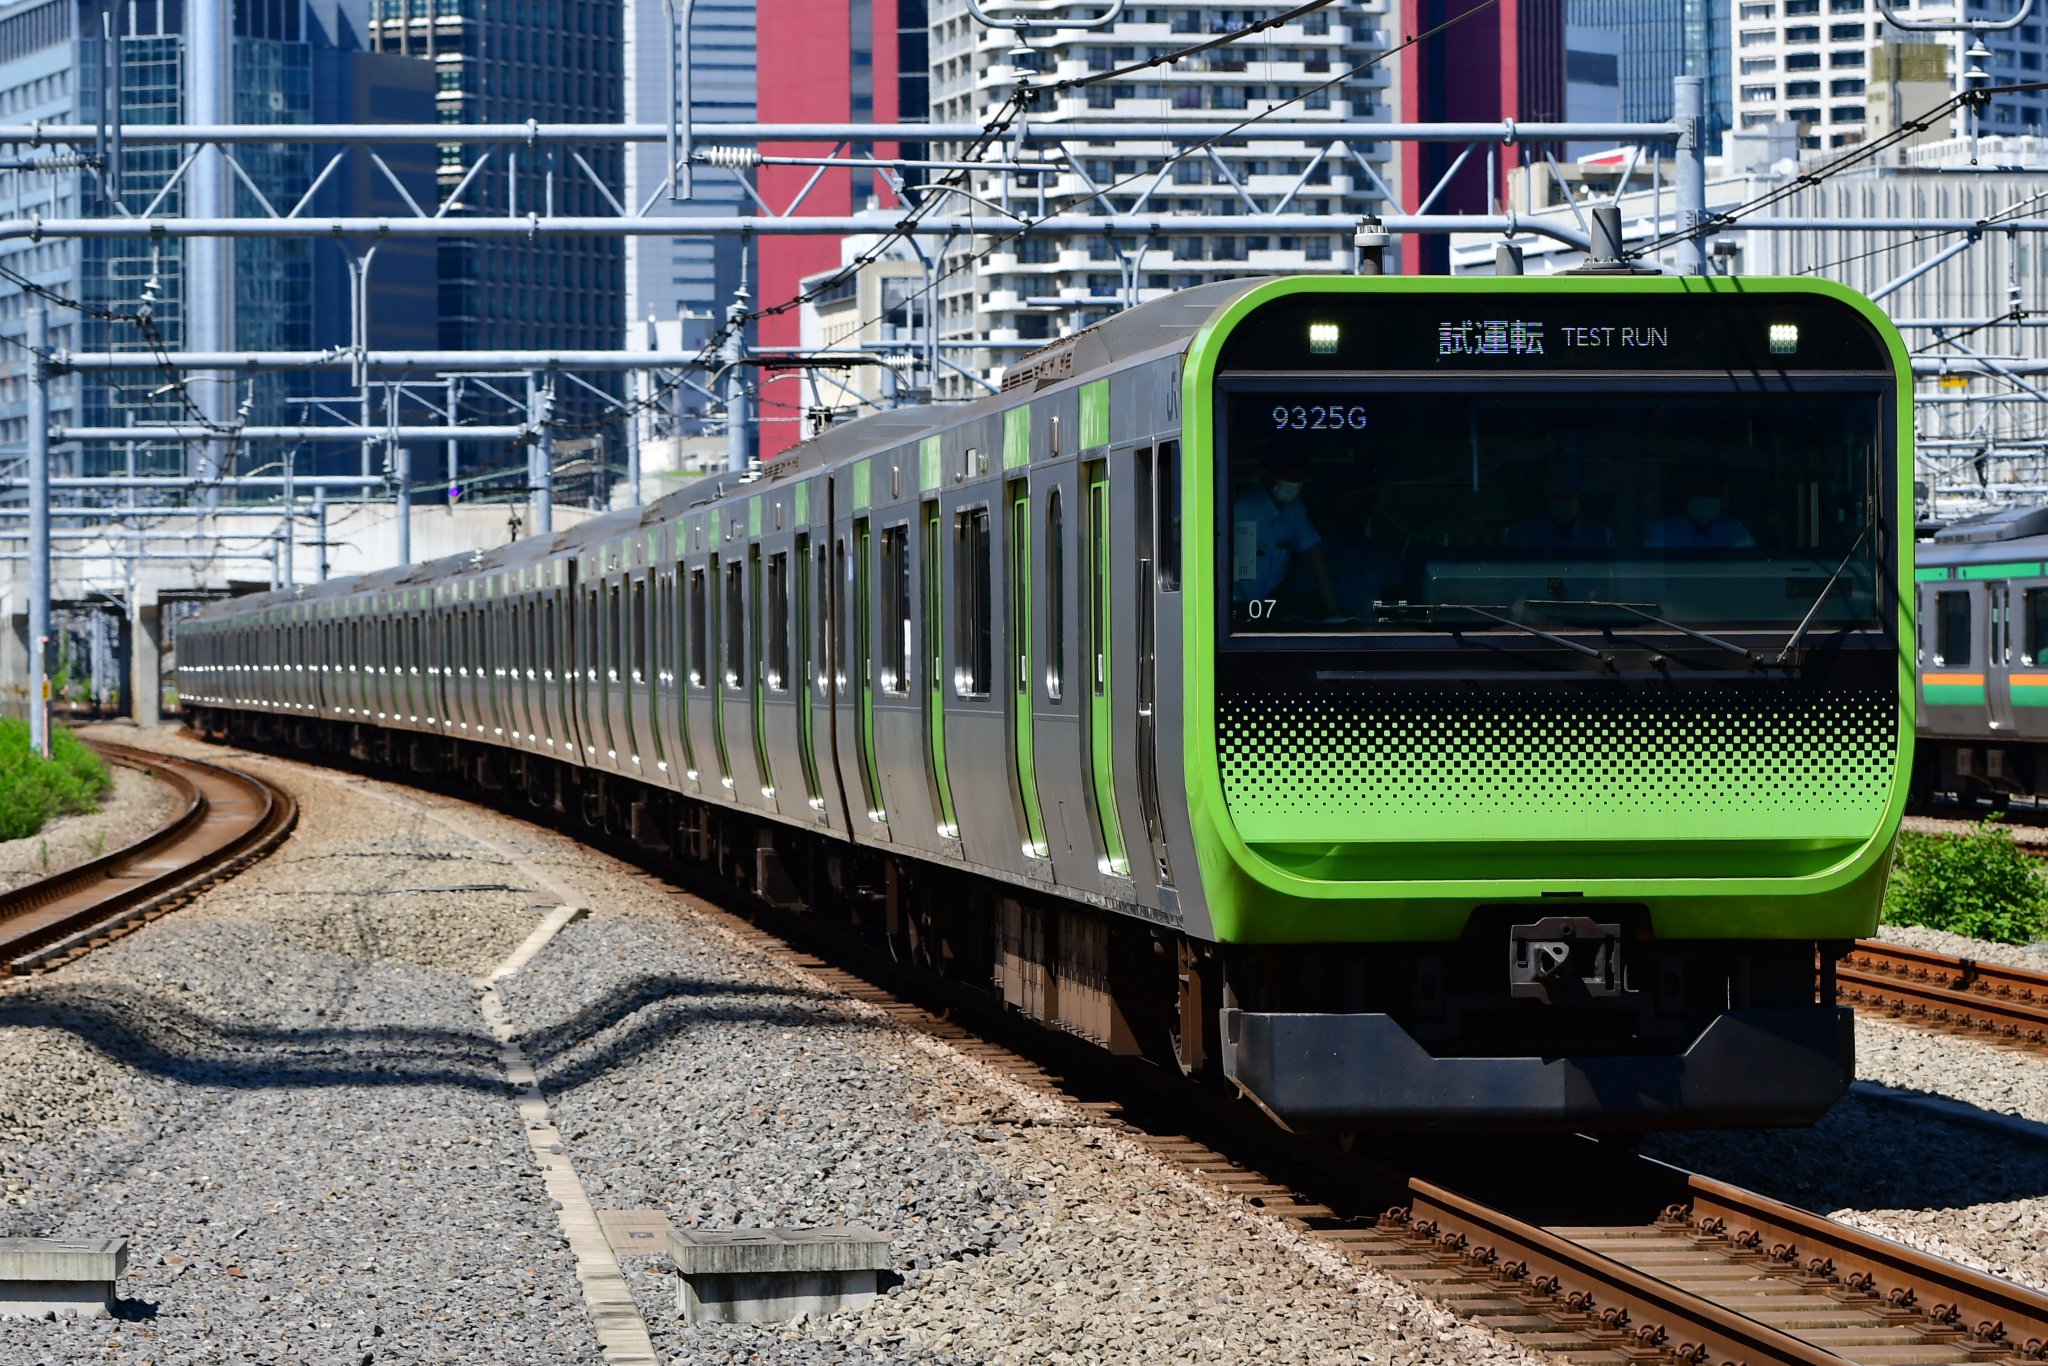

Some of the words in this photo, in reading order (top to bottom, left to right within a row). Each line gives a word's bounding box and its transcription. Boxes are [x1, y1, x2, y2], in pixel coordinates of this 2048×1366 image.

[1438, 319, 1545, 355] 試運転
[1561, 327, 1616, 347] TEST
[1621, 327, 1668, 347] RUN
[1272, 405, 1367, 430] 9325G
[1248, 599, 1277, 619] 07
